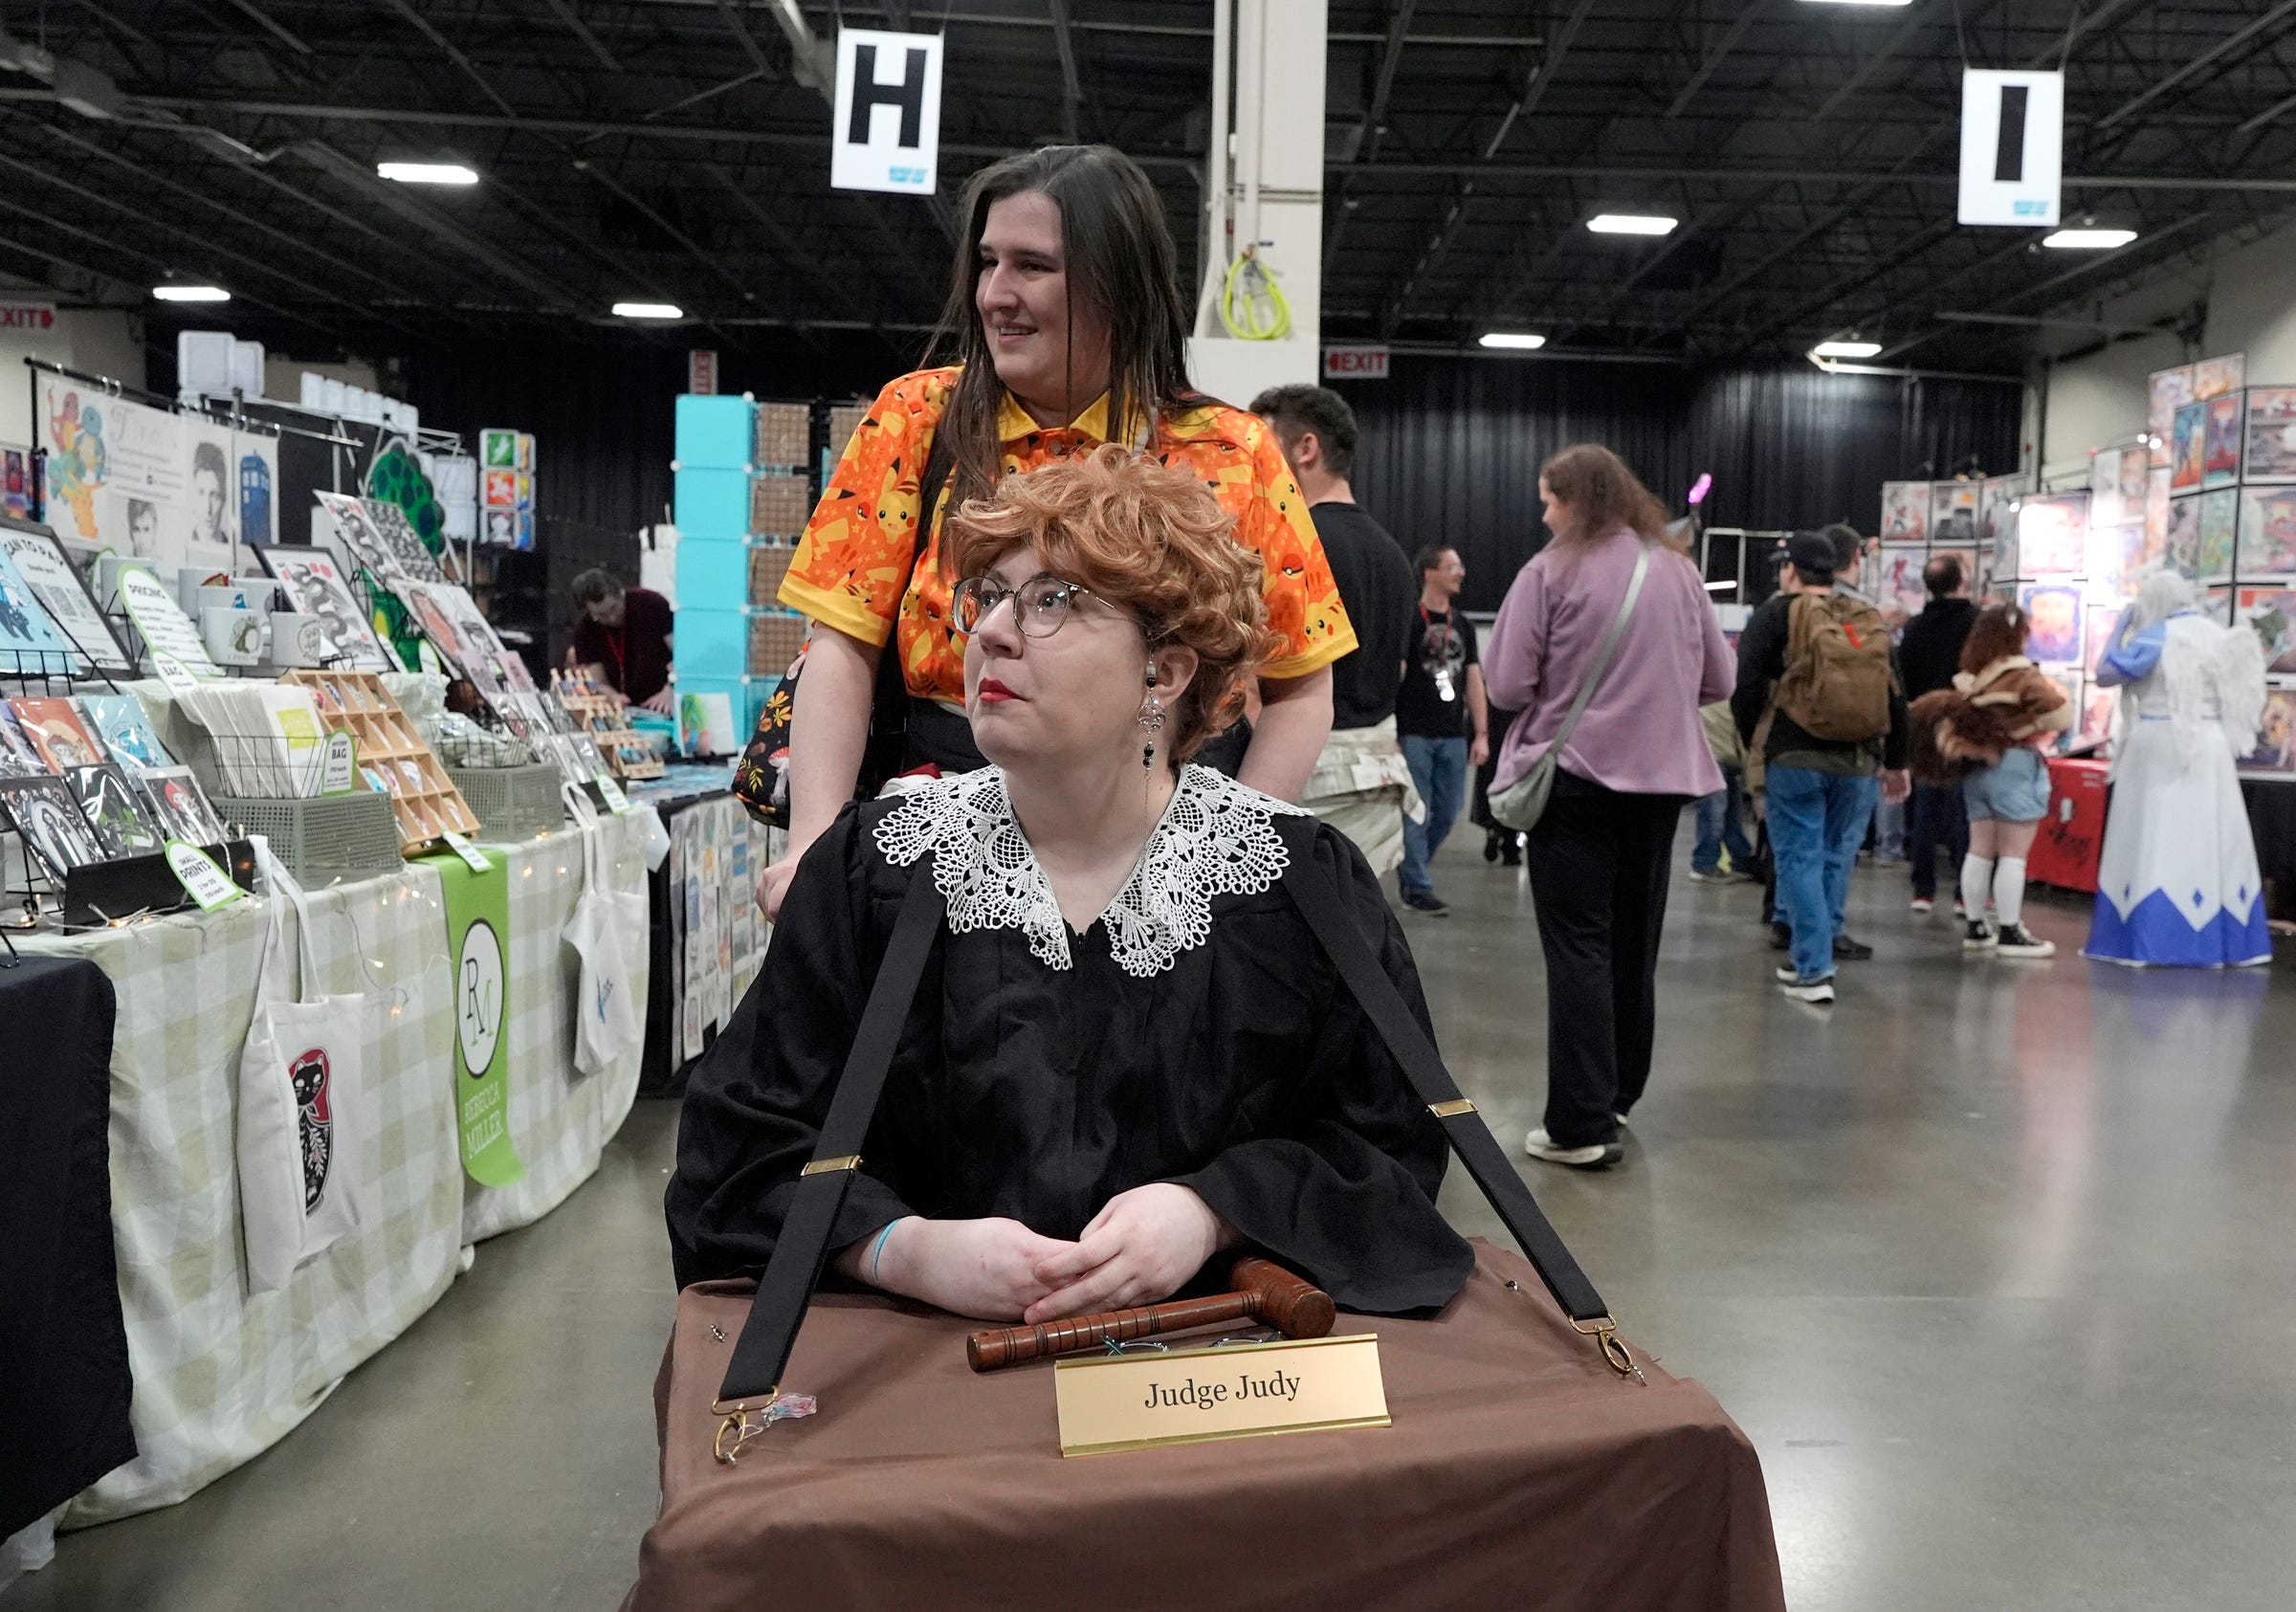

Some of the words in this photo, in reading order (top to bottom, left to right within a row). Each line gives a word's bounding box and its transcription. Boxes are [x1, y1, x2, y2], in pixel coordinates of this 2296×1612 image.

[848, 44, 928, 148] H
[1995, 85, 2028, 182] I
[0, 306, 39, 329] XIT
[1340, 351, 1386, 372] EXIT
[331, 748, 347, 761] BAG
[179, 859, 212, 881] PRINTS
[466, 1110, 504, 1160] MILLER
[1143, 1378, 1228, 1410] Judge
[1234, 1369, 1301, 1402] Judy
